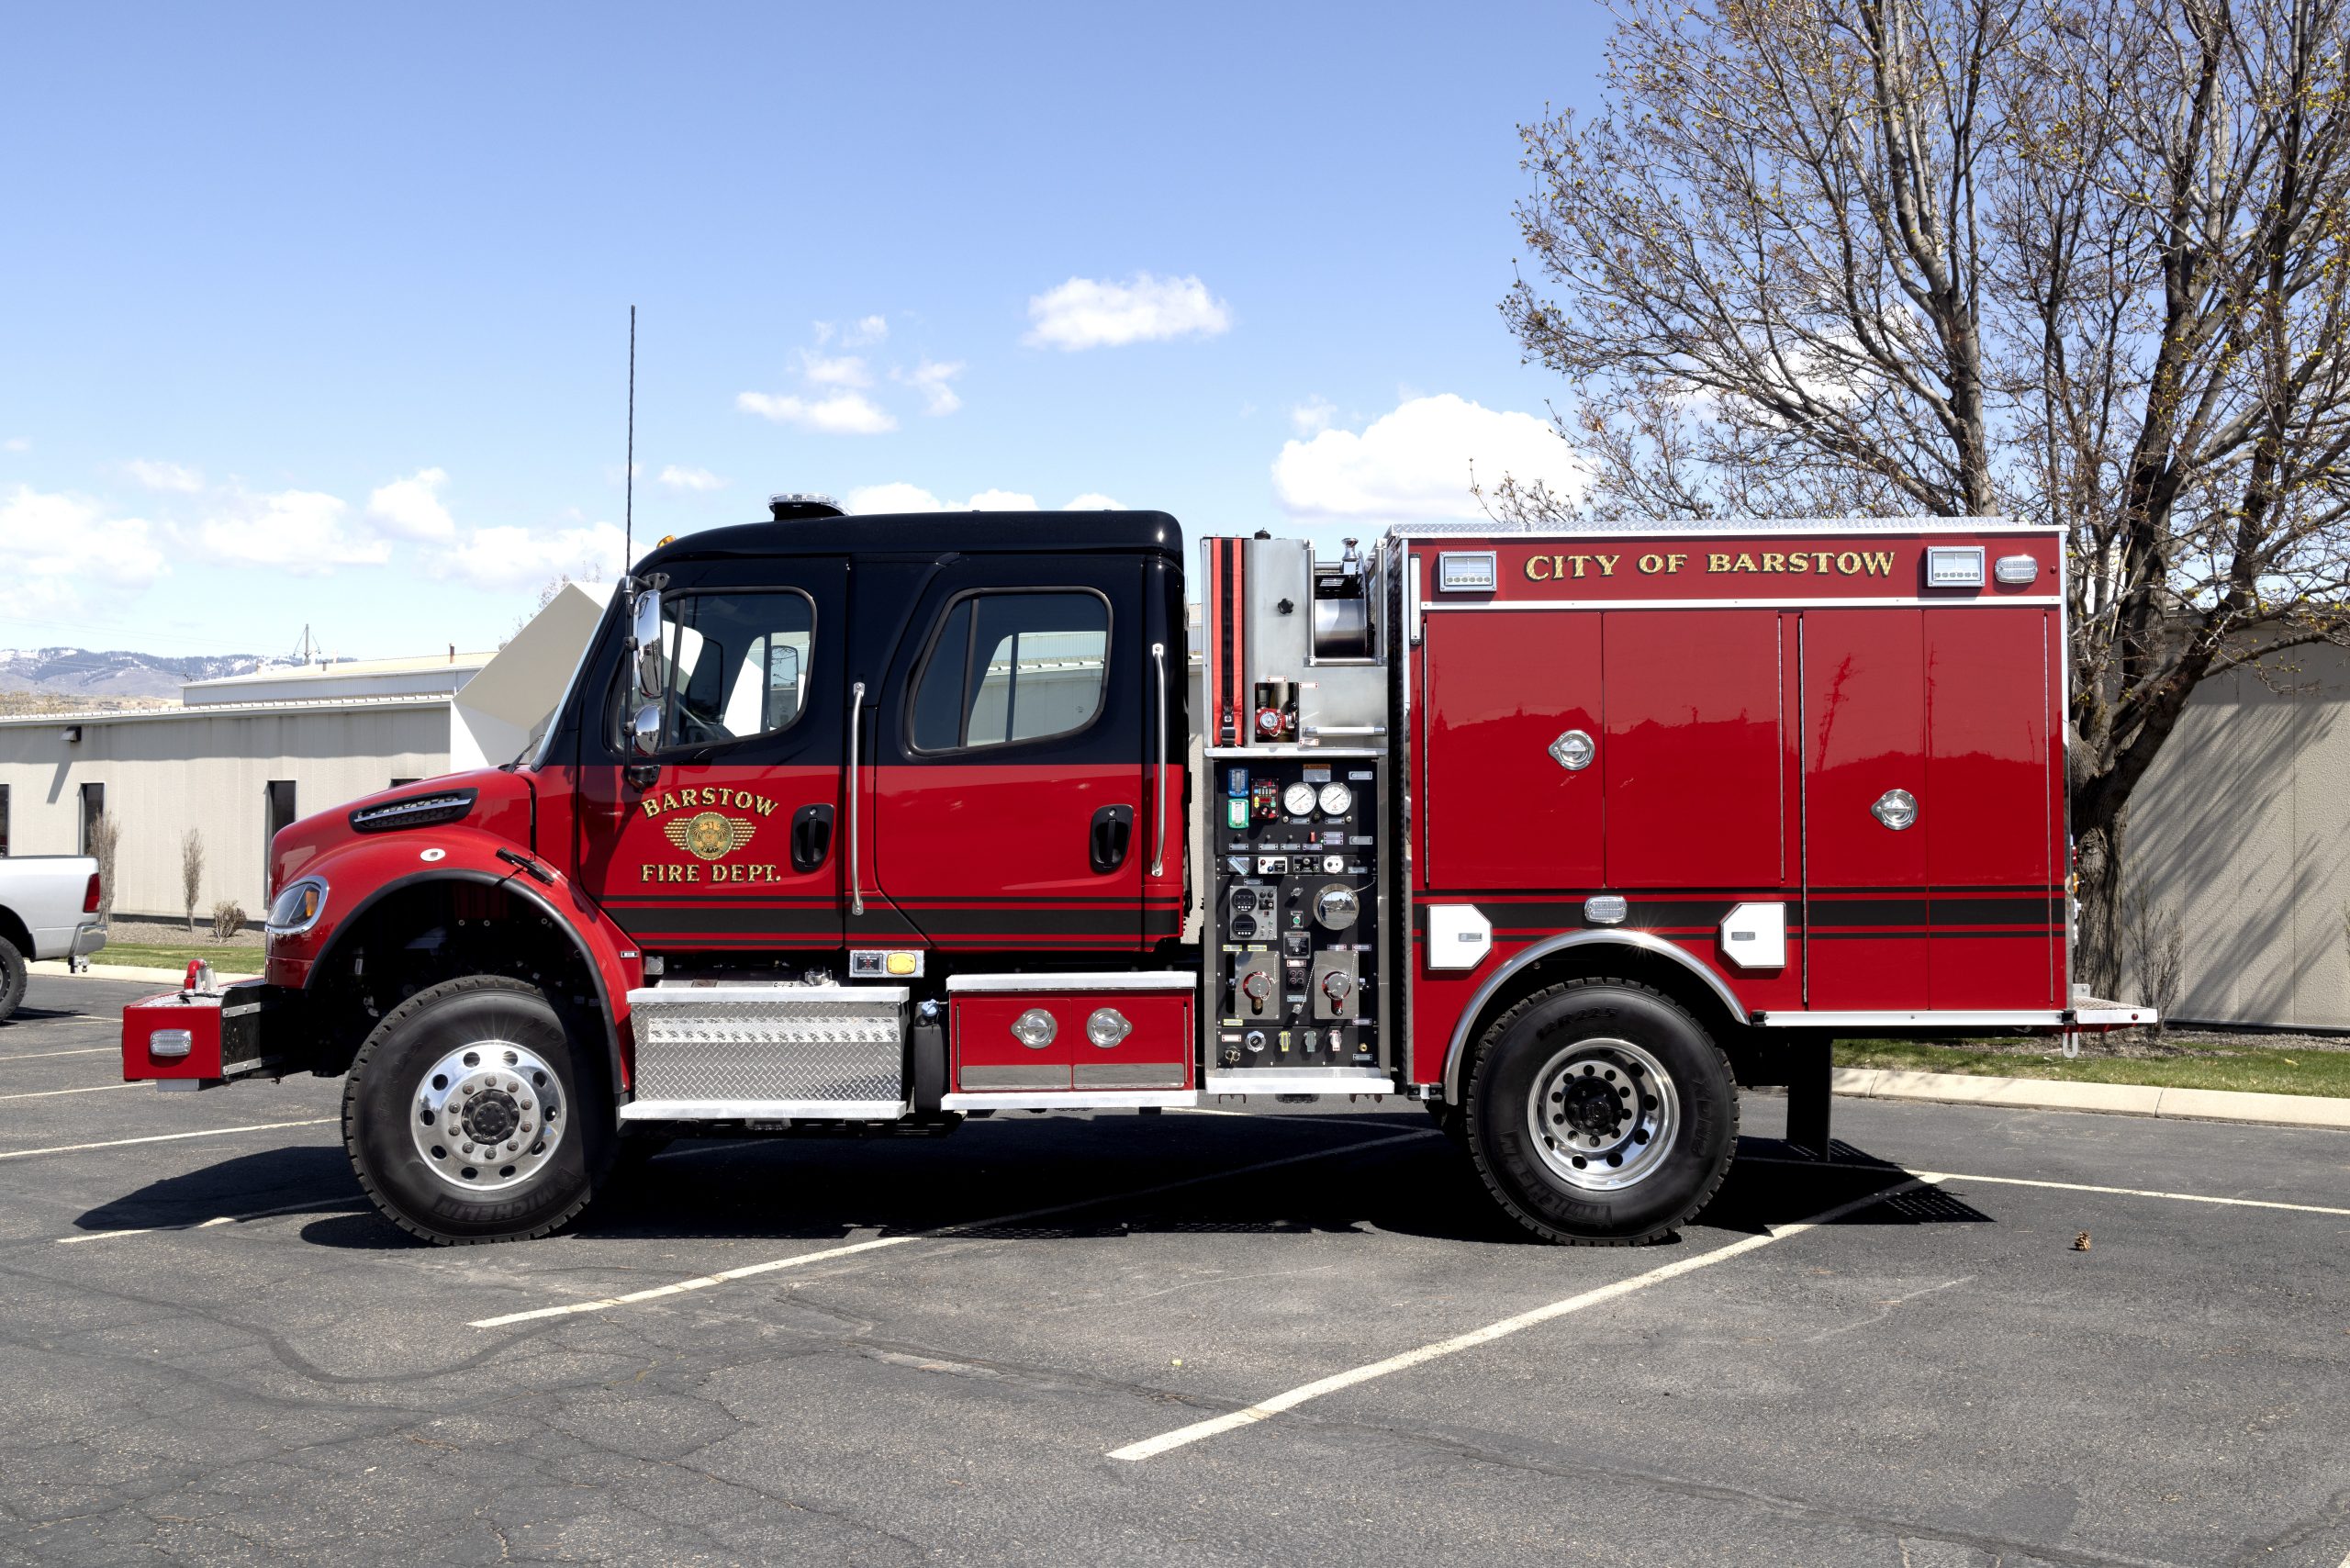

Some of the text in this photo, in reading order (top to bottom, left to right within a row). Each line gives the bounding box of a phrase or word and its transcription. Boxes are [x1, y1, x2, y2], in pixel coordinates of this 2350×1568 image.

[1525, 552, 1896, 581] CITY OF BARSTOW
[641, 787, 778, 819] BARSTOW
[641, 864, 781, 883] FIRE DEPT.
[433, 1187, 554, 1221] MICHELIN
